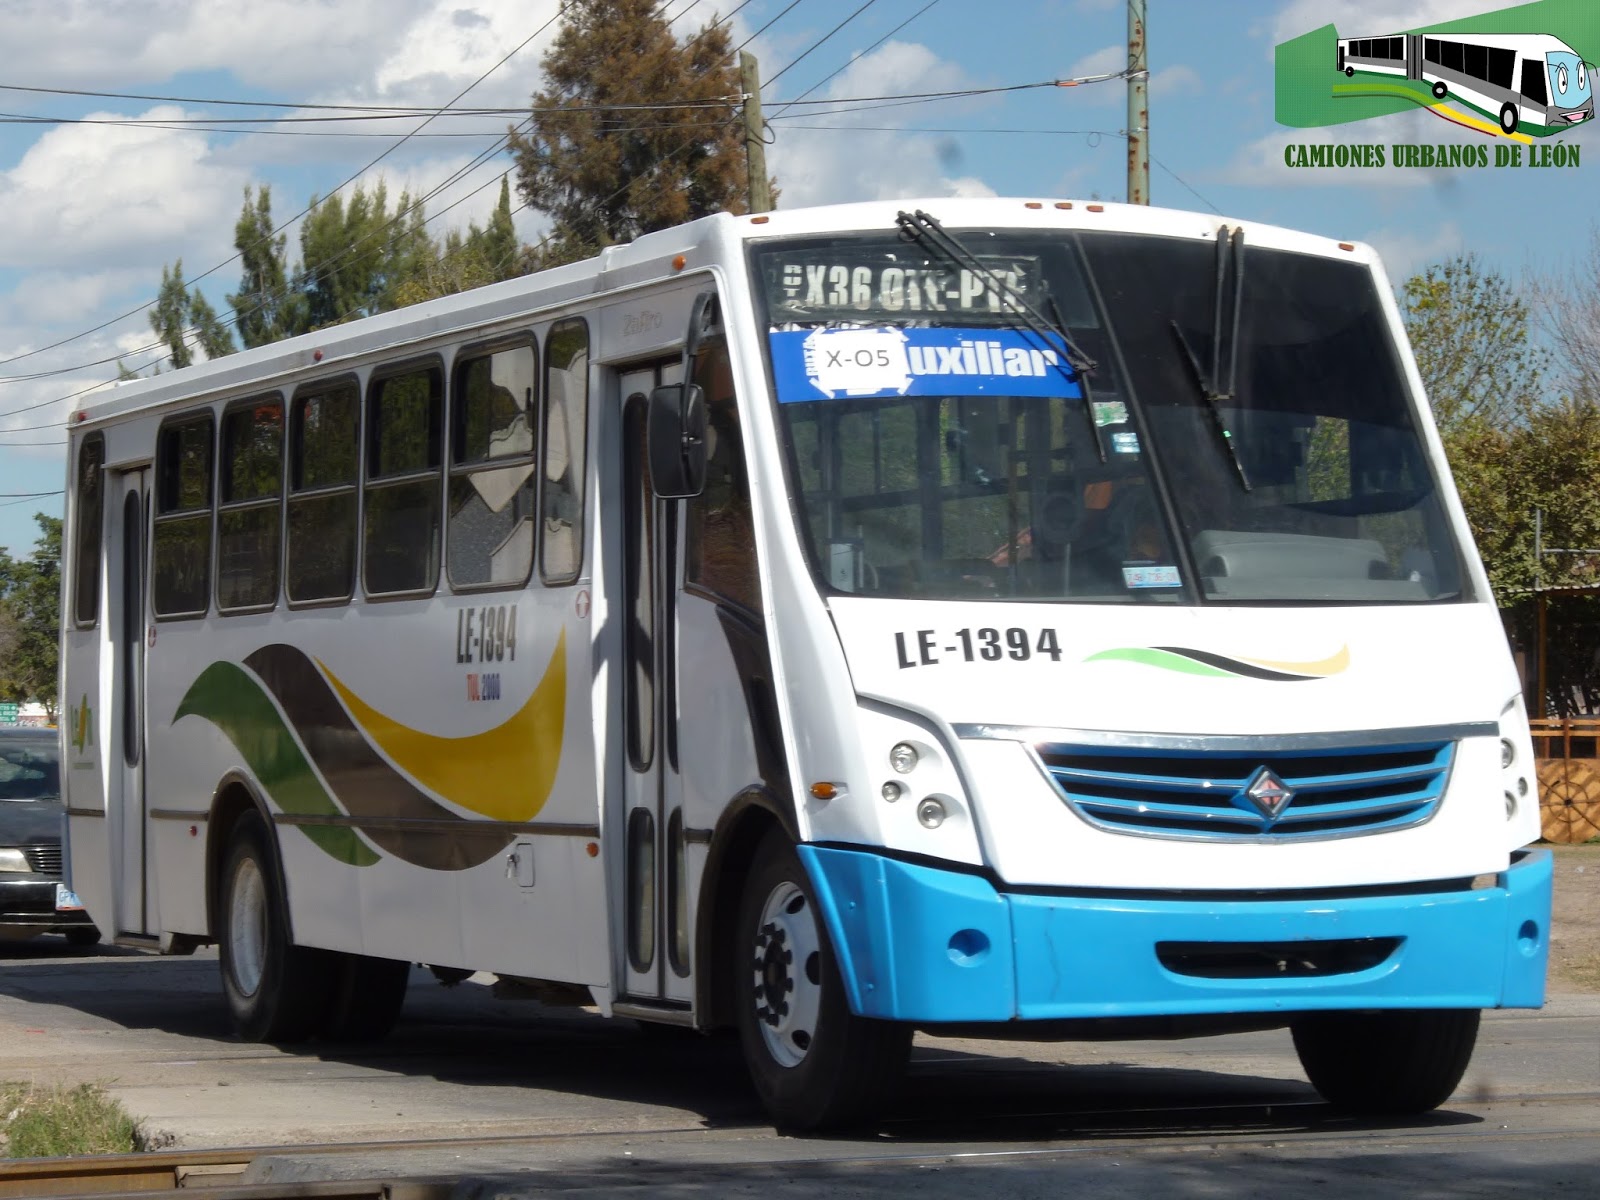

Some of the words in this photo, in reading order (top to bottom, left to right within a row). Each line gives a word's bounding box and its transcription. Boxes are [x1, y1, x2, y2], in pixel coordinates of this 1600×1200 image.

[806, 264, 872, 311] X36
[902, 340, 1058, 377] uxiliar
[457, 606, 516, 663] LE-1394
[895, 627, 1063, 670] LE-1394
